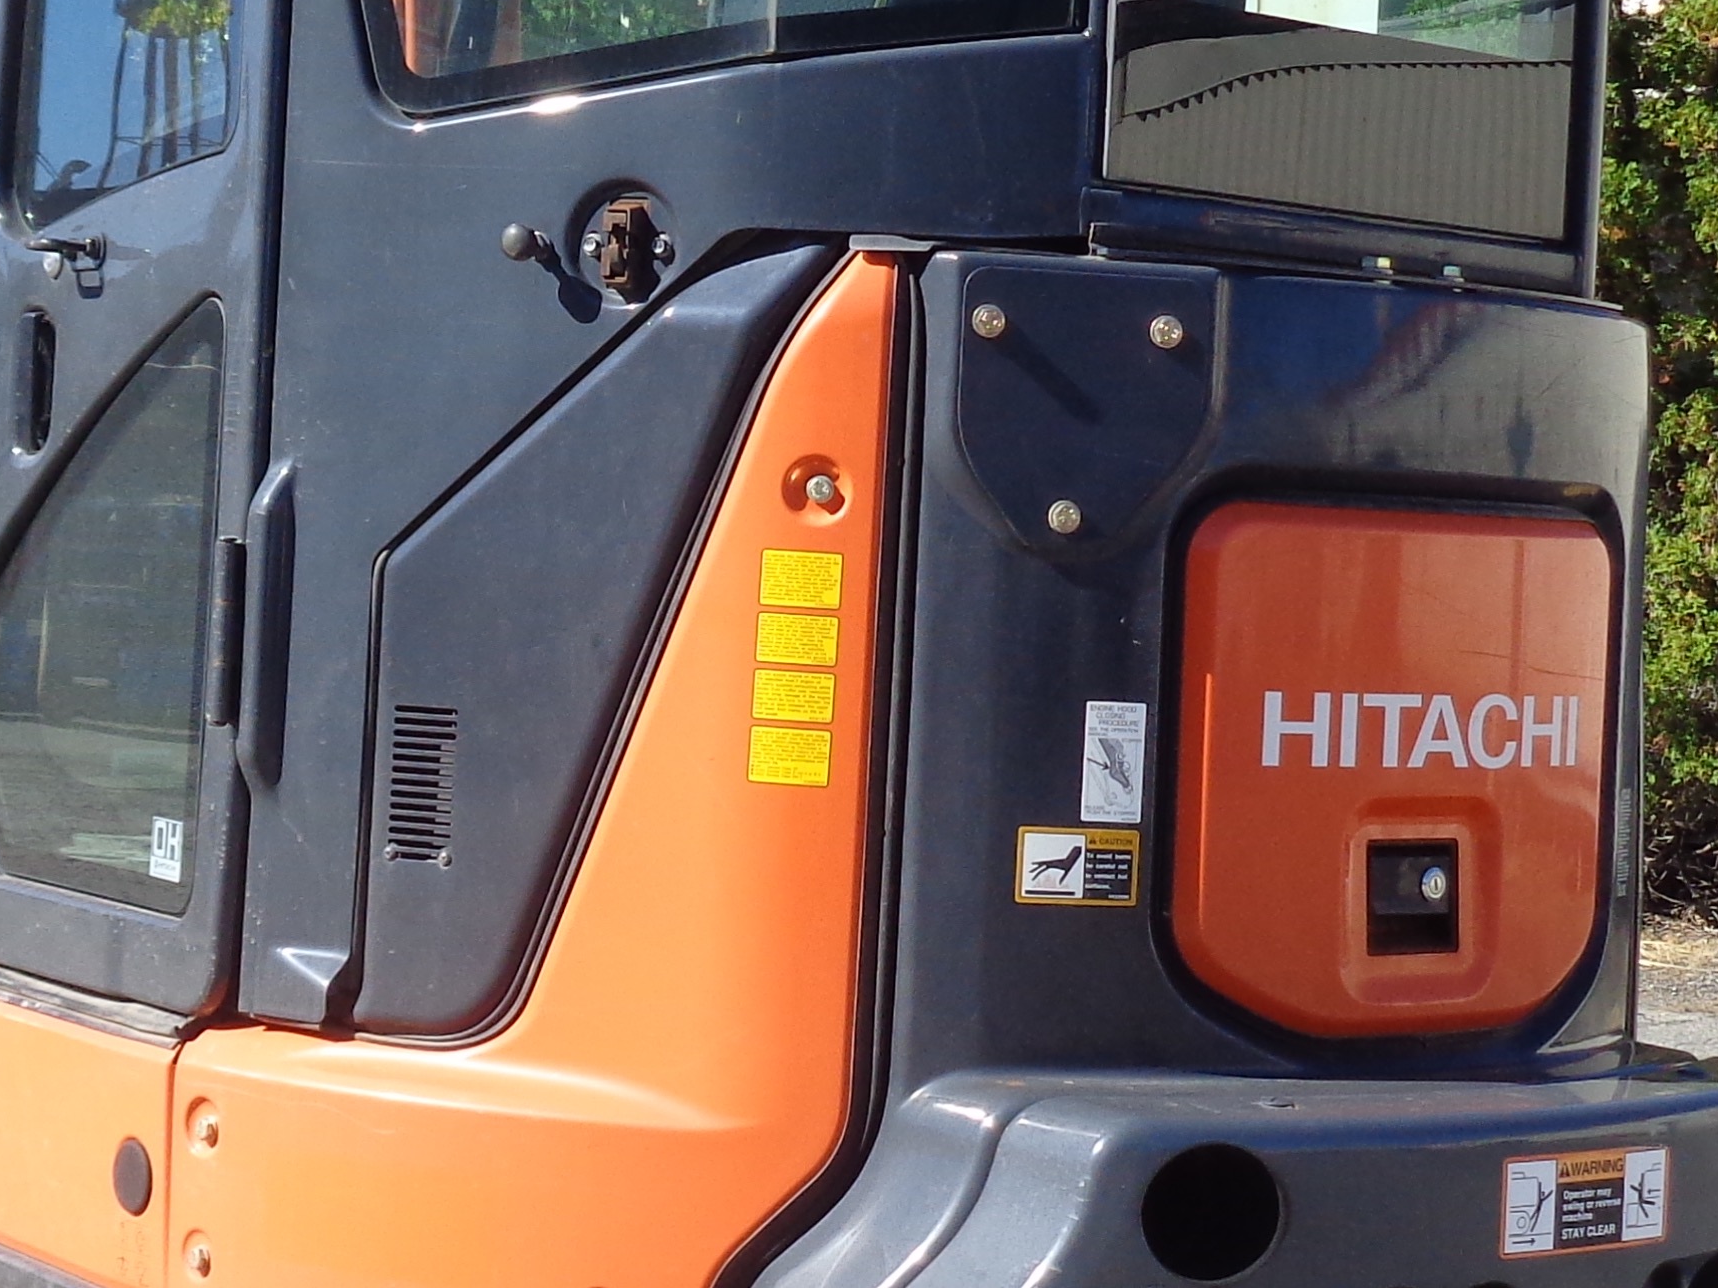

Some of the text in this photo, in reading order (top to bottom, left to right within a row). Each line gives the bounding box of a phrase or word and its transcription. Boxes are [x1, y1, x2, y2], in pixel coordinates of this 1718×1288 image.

[1261, 690, 1580, 770] HITACHI
[1570, 1158, 1623, 1176] WARNING
[1563, 1188, 1612, 1202] Operator may
[1562, 1201, 1585, 1213] swing
[1562, 1212, 1593, 1223] machine
[1561, 1223, 1616, 1240] STAY CLEAR
